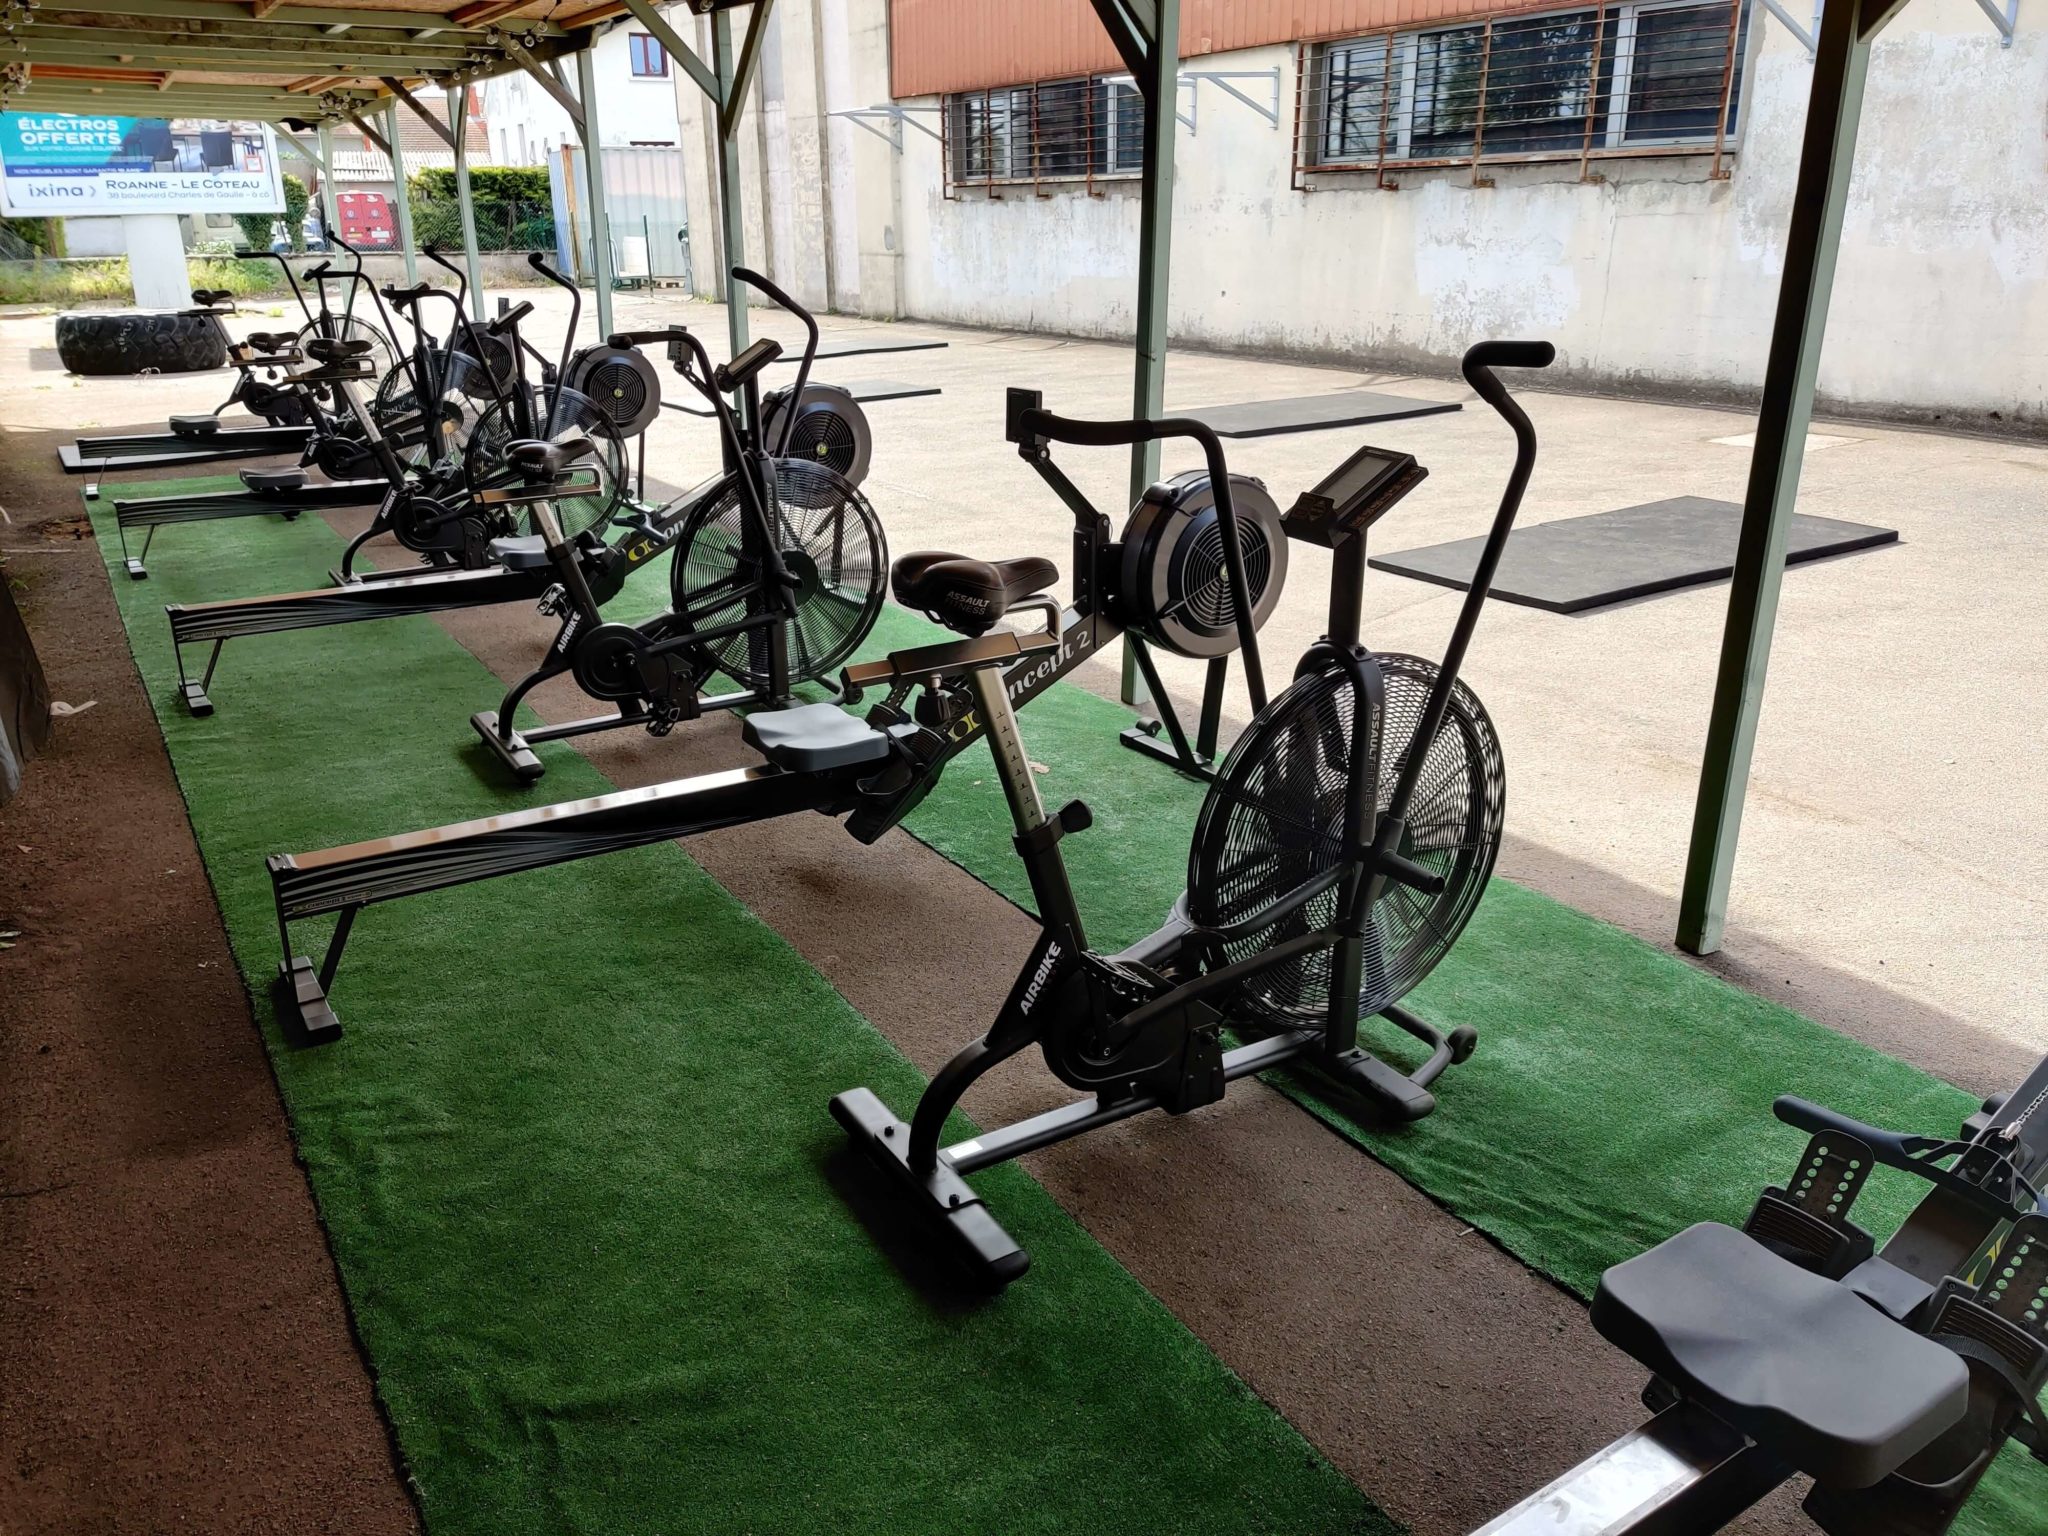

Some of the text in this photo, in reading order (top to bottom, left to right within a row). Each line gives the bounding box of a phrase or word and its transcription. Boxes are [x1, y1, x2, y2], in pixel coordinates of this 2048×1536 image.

[17, 116, 119, 131] ÉLECTROS
[19, 132, 122, 145] OFFERTS
[28, 183, 84, 197] ixina
[106, 179, 168, 189] ROANNE
[181, 179, 200, 189] LE
[202, 179, 260, 189] COTEAU
[121, 191, 167, 199] boulevard
[168, 191, 202, 199] Charles
[203, 191, 215, 199] de
[216, 191, 244, 199] Gaulle
[944, 597, 987, 616] FITNESS
[946, 589, 991, 608] ASSAULT
[556, 611, 582, 654] AIRBIKE
[1076, 630, 1091, 649] 2
[1019, 940, 1062, 1017] AIRBIKE
